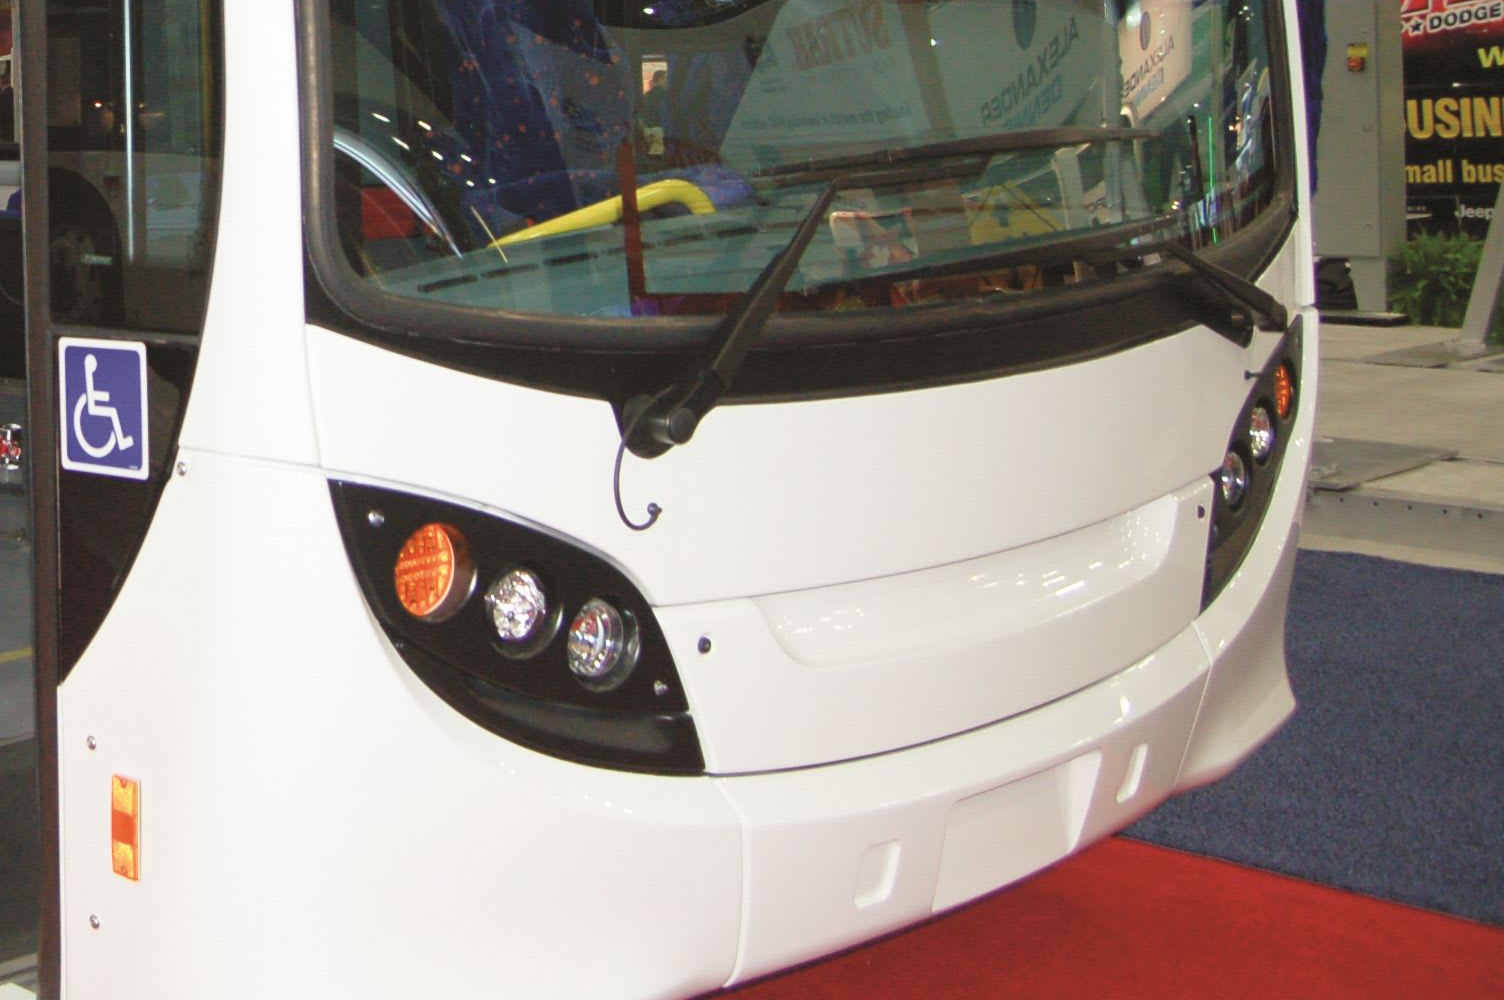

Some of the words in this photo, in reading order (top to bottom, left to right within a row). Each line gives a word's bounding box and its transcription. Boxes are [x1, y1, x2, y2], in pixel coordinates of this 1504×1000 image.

[1429, 2, 1502, 31] DODGE
[1405, 159, 1453, 185] mall
[1453, 203, 1495, 220] Jeep
